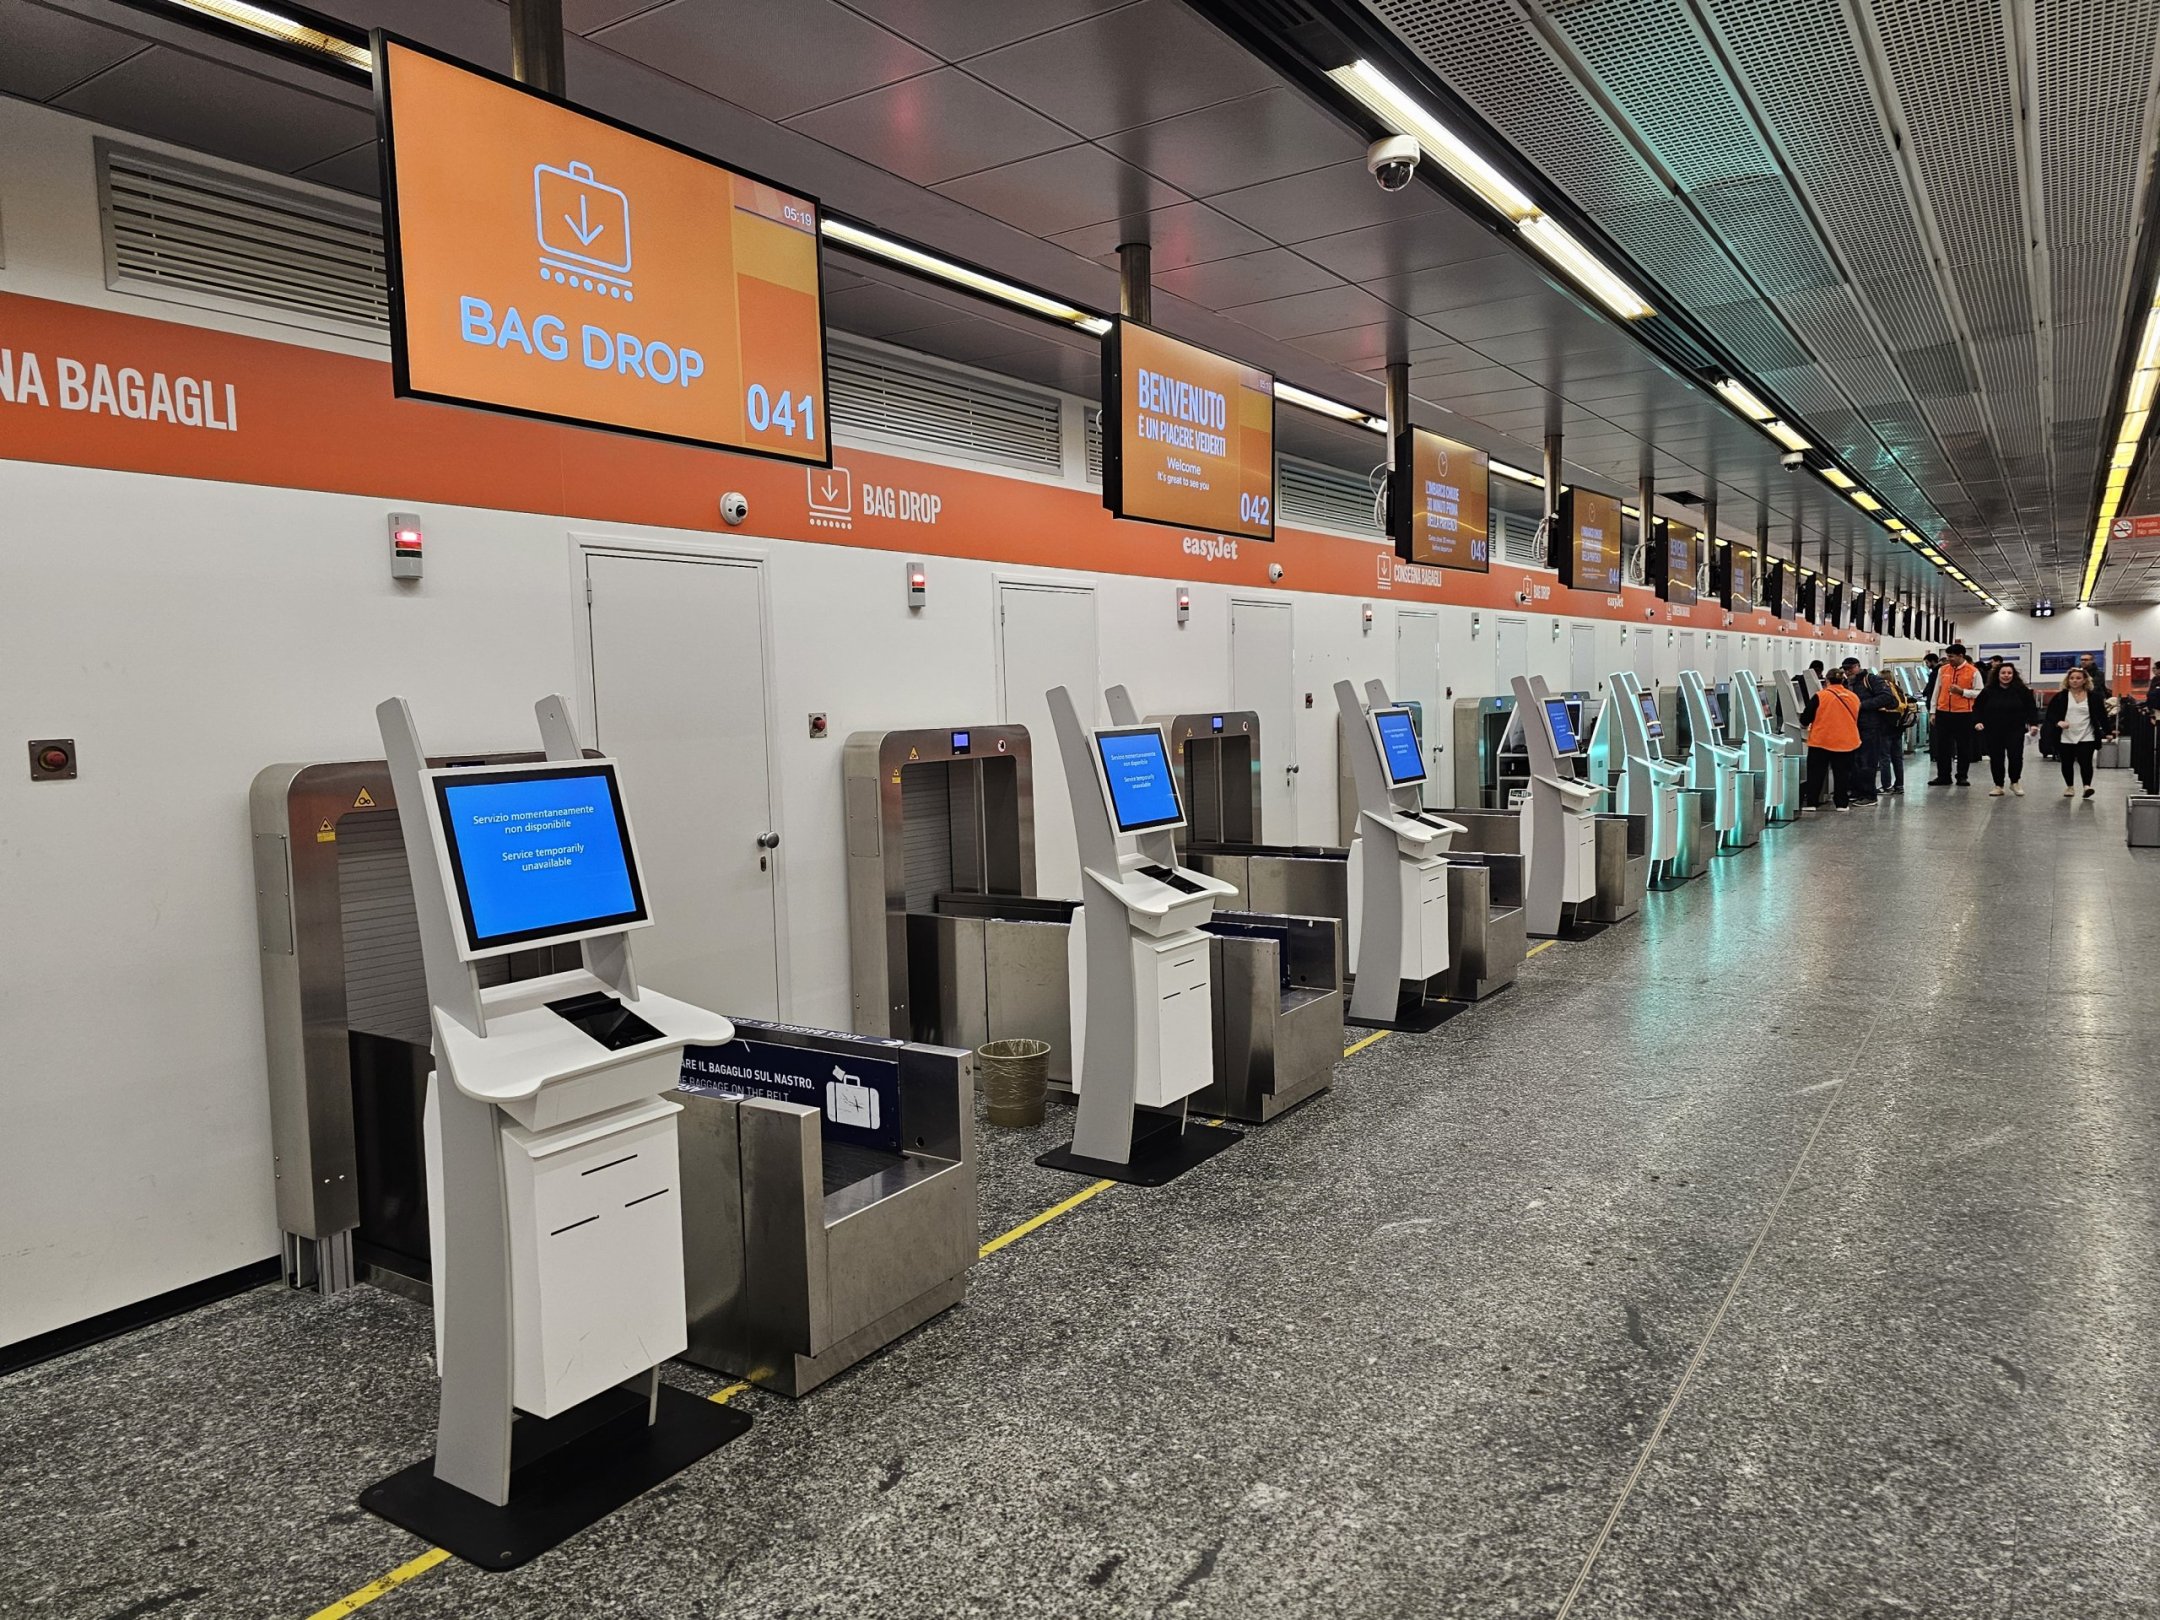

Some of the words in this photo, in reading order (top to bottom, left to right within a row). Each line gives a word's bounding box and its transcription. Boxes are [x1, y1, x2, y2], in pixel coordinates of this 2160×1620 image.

[783, 205, 813, 227] 05:19
[460, 295, 569, 361] BAG
[582, 324, 705, 388] DROP
[56, 356, 238, 432] BAGAGLI
[1138, 367, 1226, 431] BENVENUTO
[747, 383, 815, 441] 041
[1138, 412, 1145, 437] È
[1146, 416, 1159, 441] UN
[1160, 420, 1195, 450] PIACERE
[1195, 430, 1226, 458] VEDERTI
[1167, 456, 1202, 475] Welcome
[862, 483, 897, 519] BAG
[899, 489, 942, 525] DROP
[1240, 492, 1270, 526] 042
[1182, 536, 1239, 562] easyJet
[1470, 538, 1487, 562] 043
[473, 812, 509, 825] Servizio
[511, 805, 594, 821] momentaneamente
[504, 825, 523, 834] non
[524, 819, 572, 833] disponibile
[502, 850, 534, 861] Service
[535, 842, 585, 858] temporarily
[521, 857, 572, 871] unavailable
[698, 1060, 708, 1072] IL
[708, 1062, 753, 1079] BAGAGLIO
[754, 1070, 773, 1083] SUL
[774, 1072, 815, 1090] NASTRO.
[689, 1076, 729, 1093] BAGGAGE
[731, 1083, 745, 1097] ON
[746, 1086, 764, 1098] THE
[766, 1089, 789, 1102] BELT
